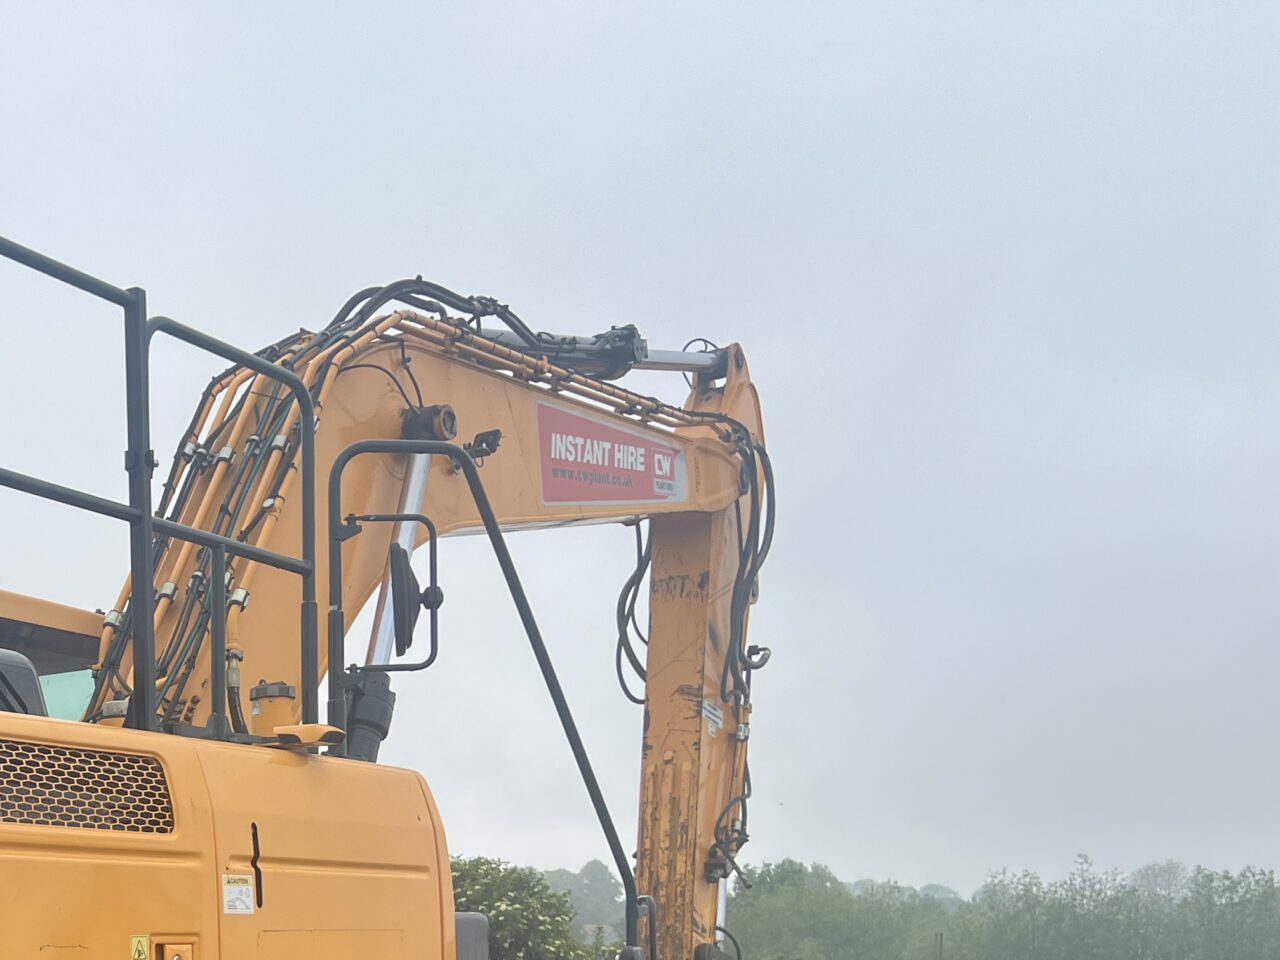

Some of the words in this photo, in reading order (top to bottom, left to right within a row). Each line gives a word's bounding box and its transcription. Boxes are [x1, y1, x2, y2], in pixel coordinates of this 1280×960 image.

[551, 432, 612, 467] INSTANT
[614, 442, 646, 472] HIRE
[552, 466, 633, 488] www.cwplant.co.uk
